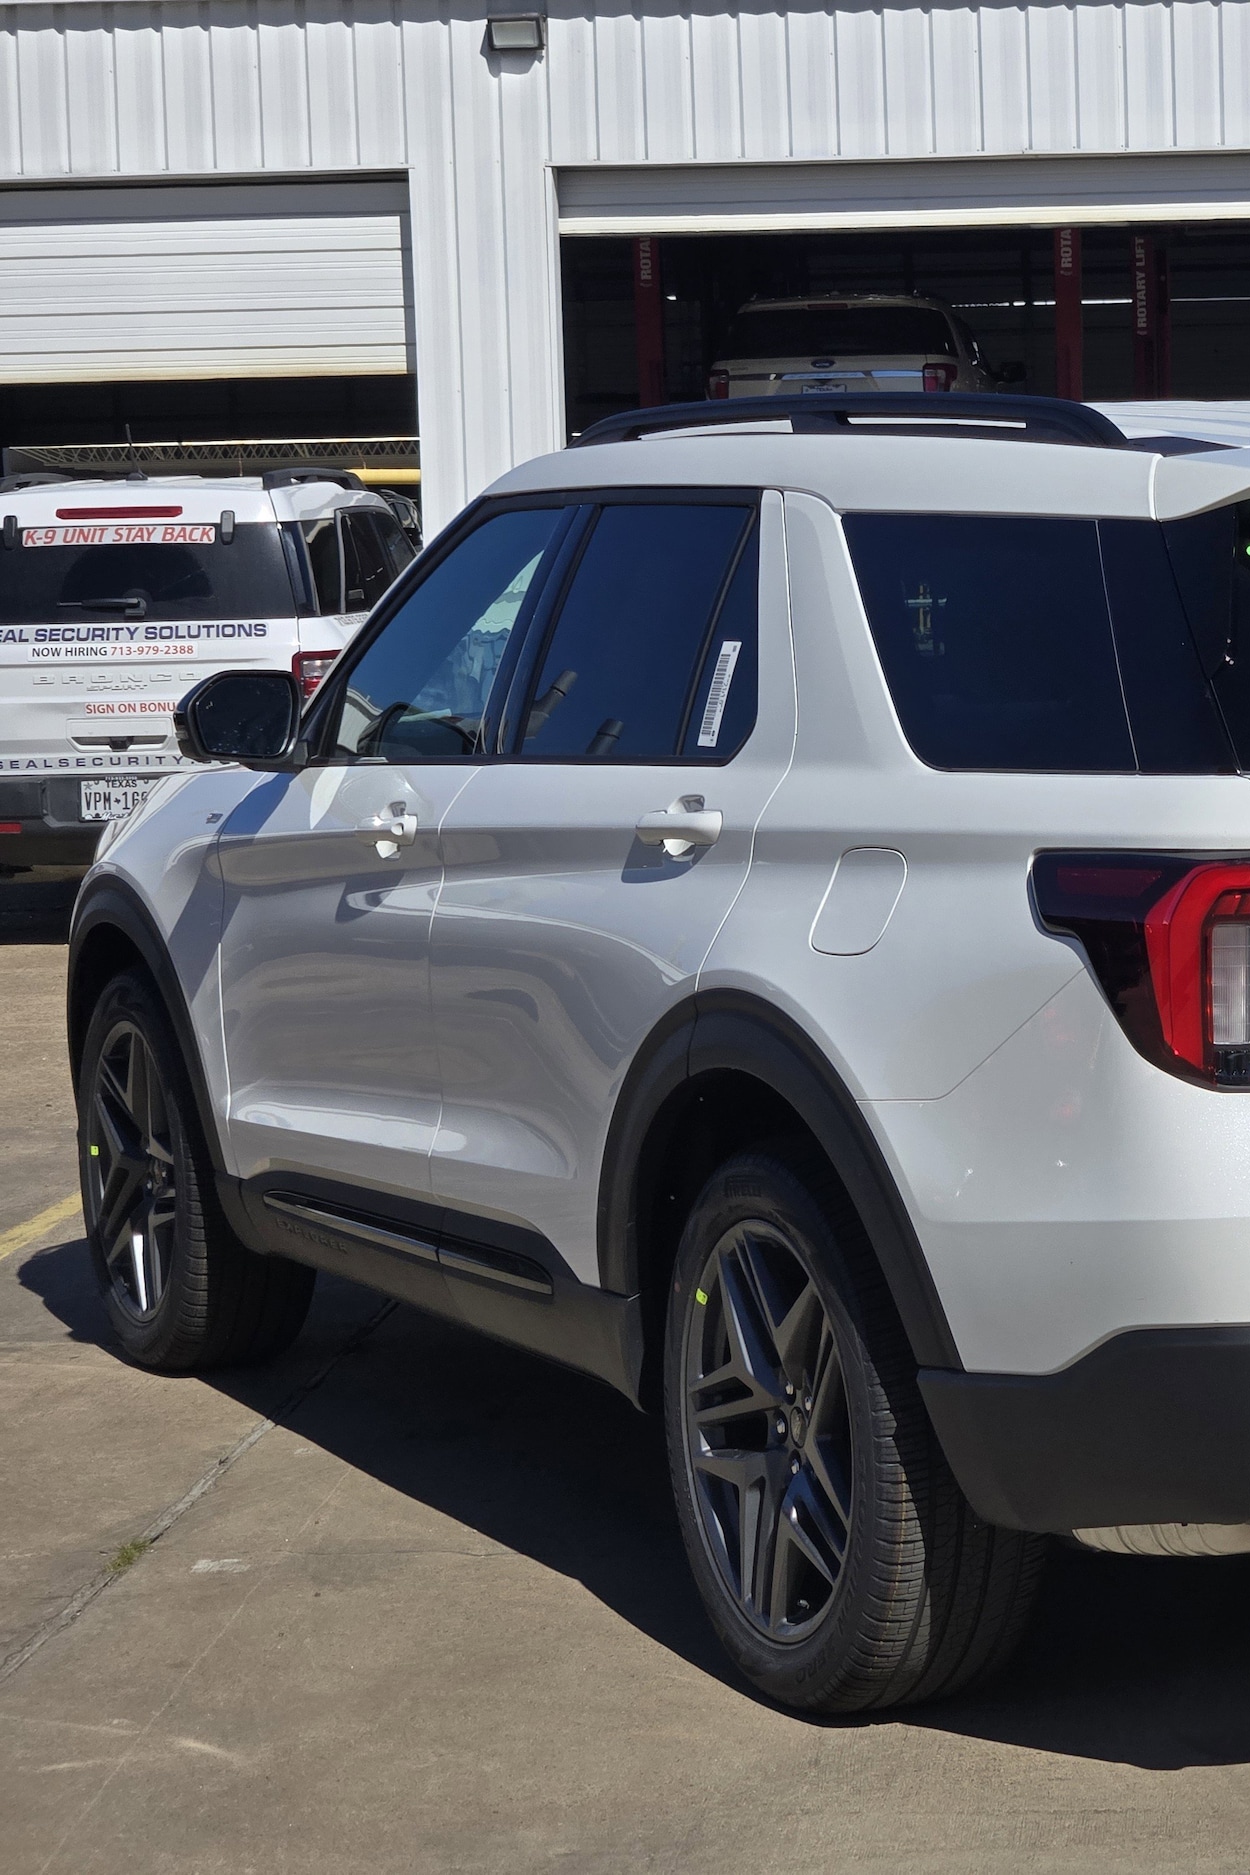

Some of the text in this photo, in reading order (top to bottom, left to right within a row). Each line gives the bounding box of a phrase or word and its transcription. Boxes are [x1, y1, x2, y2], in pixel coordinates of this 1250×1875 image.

[639, 236, 652, 280] ROTA
[1135, 236, 1147, 328] ROTARY LIFT
[23, 526, 214, 546] K-9 UNIT STAY BACK
[0, 623, 267, 643] AL SECURITY SOLUTIONS
[32, 645, 194, 658] NOW HIRING 713-979-2388
[32, 671, 202, 686] BRONCO
[86, 684, 149, 692] SPORT
[86, 703, 115, 714] SIGN
[118, 703, 137, 713] ON
[105, 779, 138, 789] TEXAS
